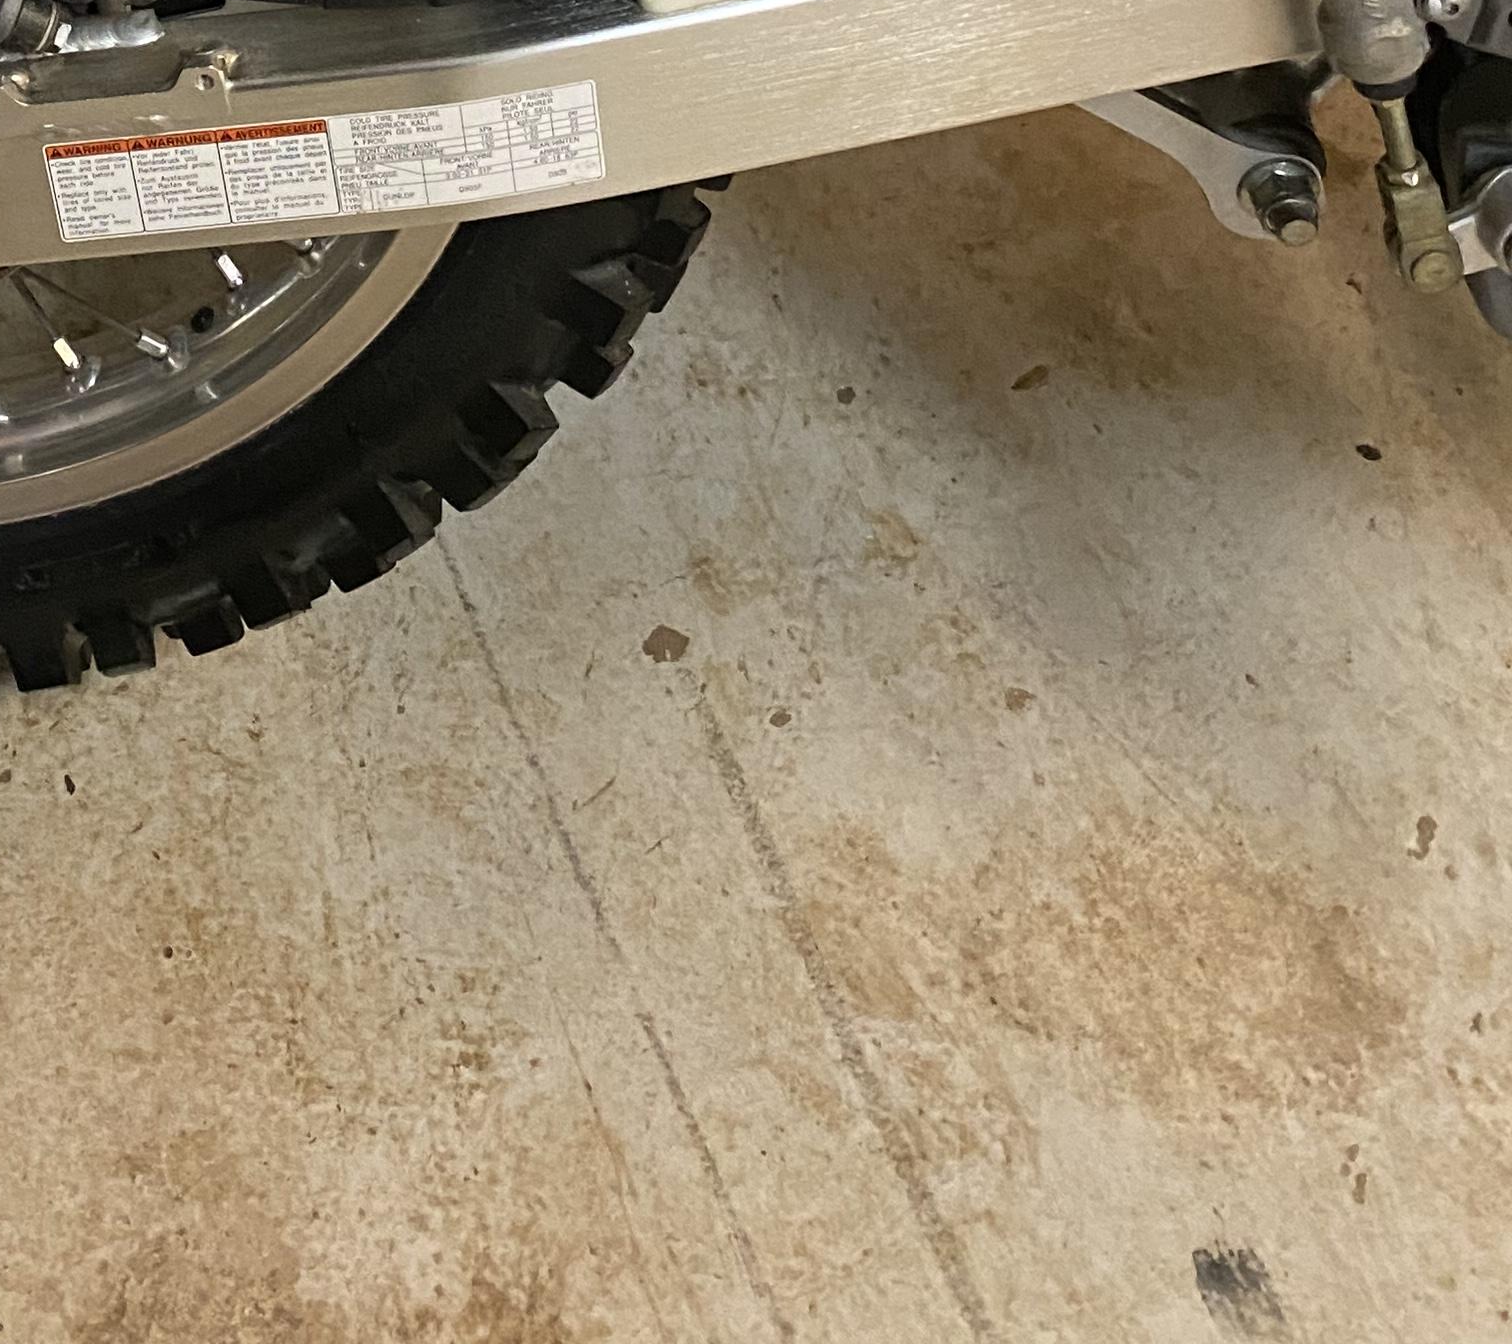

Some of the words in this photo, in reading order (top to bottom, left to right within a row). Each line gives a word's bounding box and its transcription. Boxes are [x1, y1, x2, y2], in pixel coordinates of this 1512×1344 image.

[236, 123, 323, 139] AVERTISSEMENT
[146, 134, 212, 147] WARNUNG
[63, 143, 121, 156] WARNING
